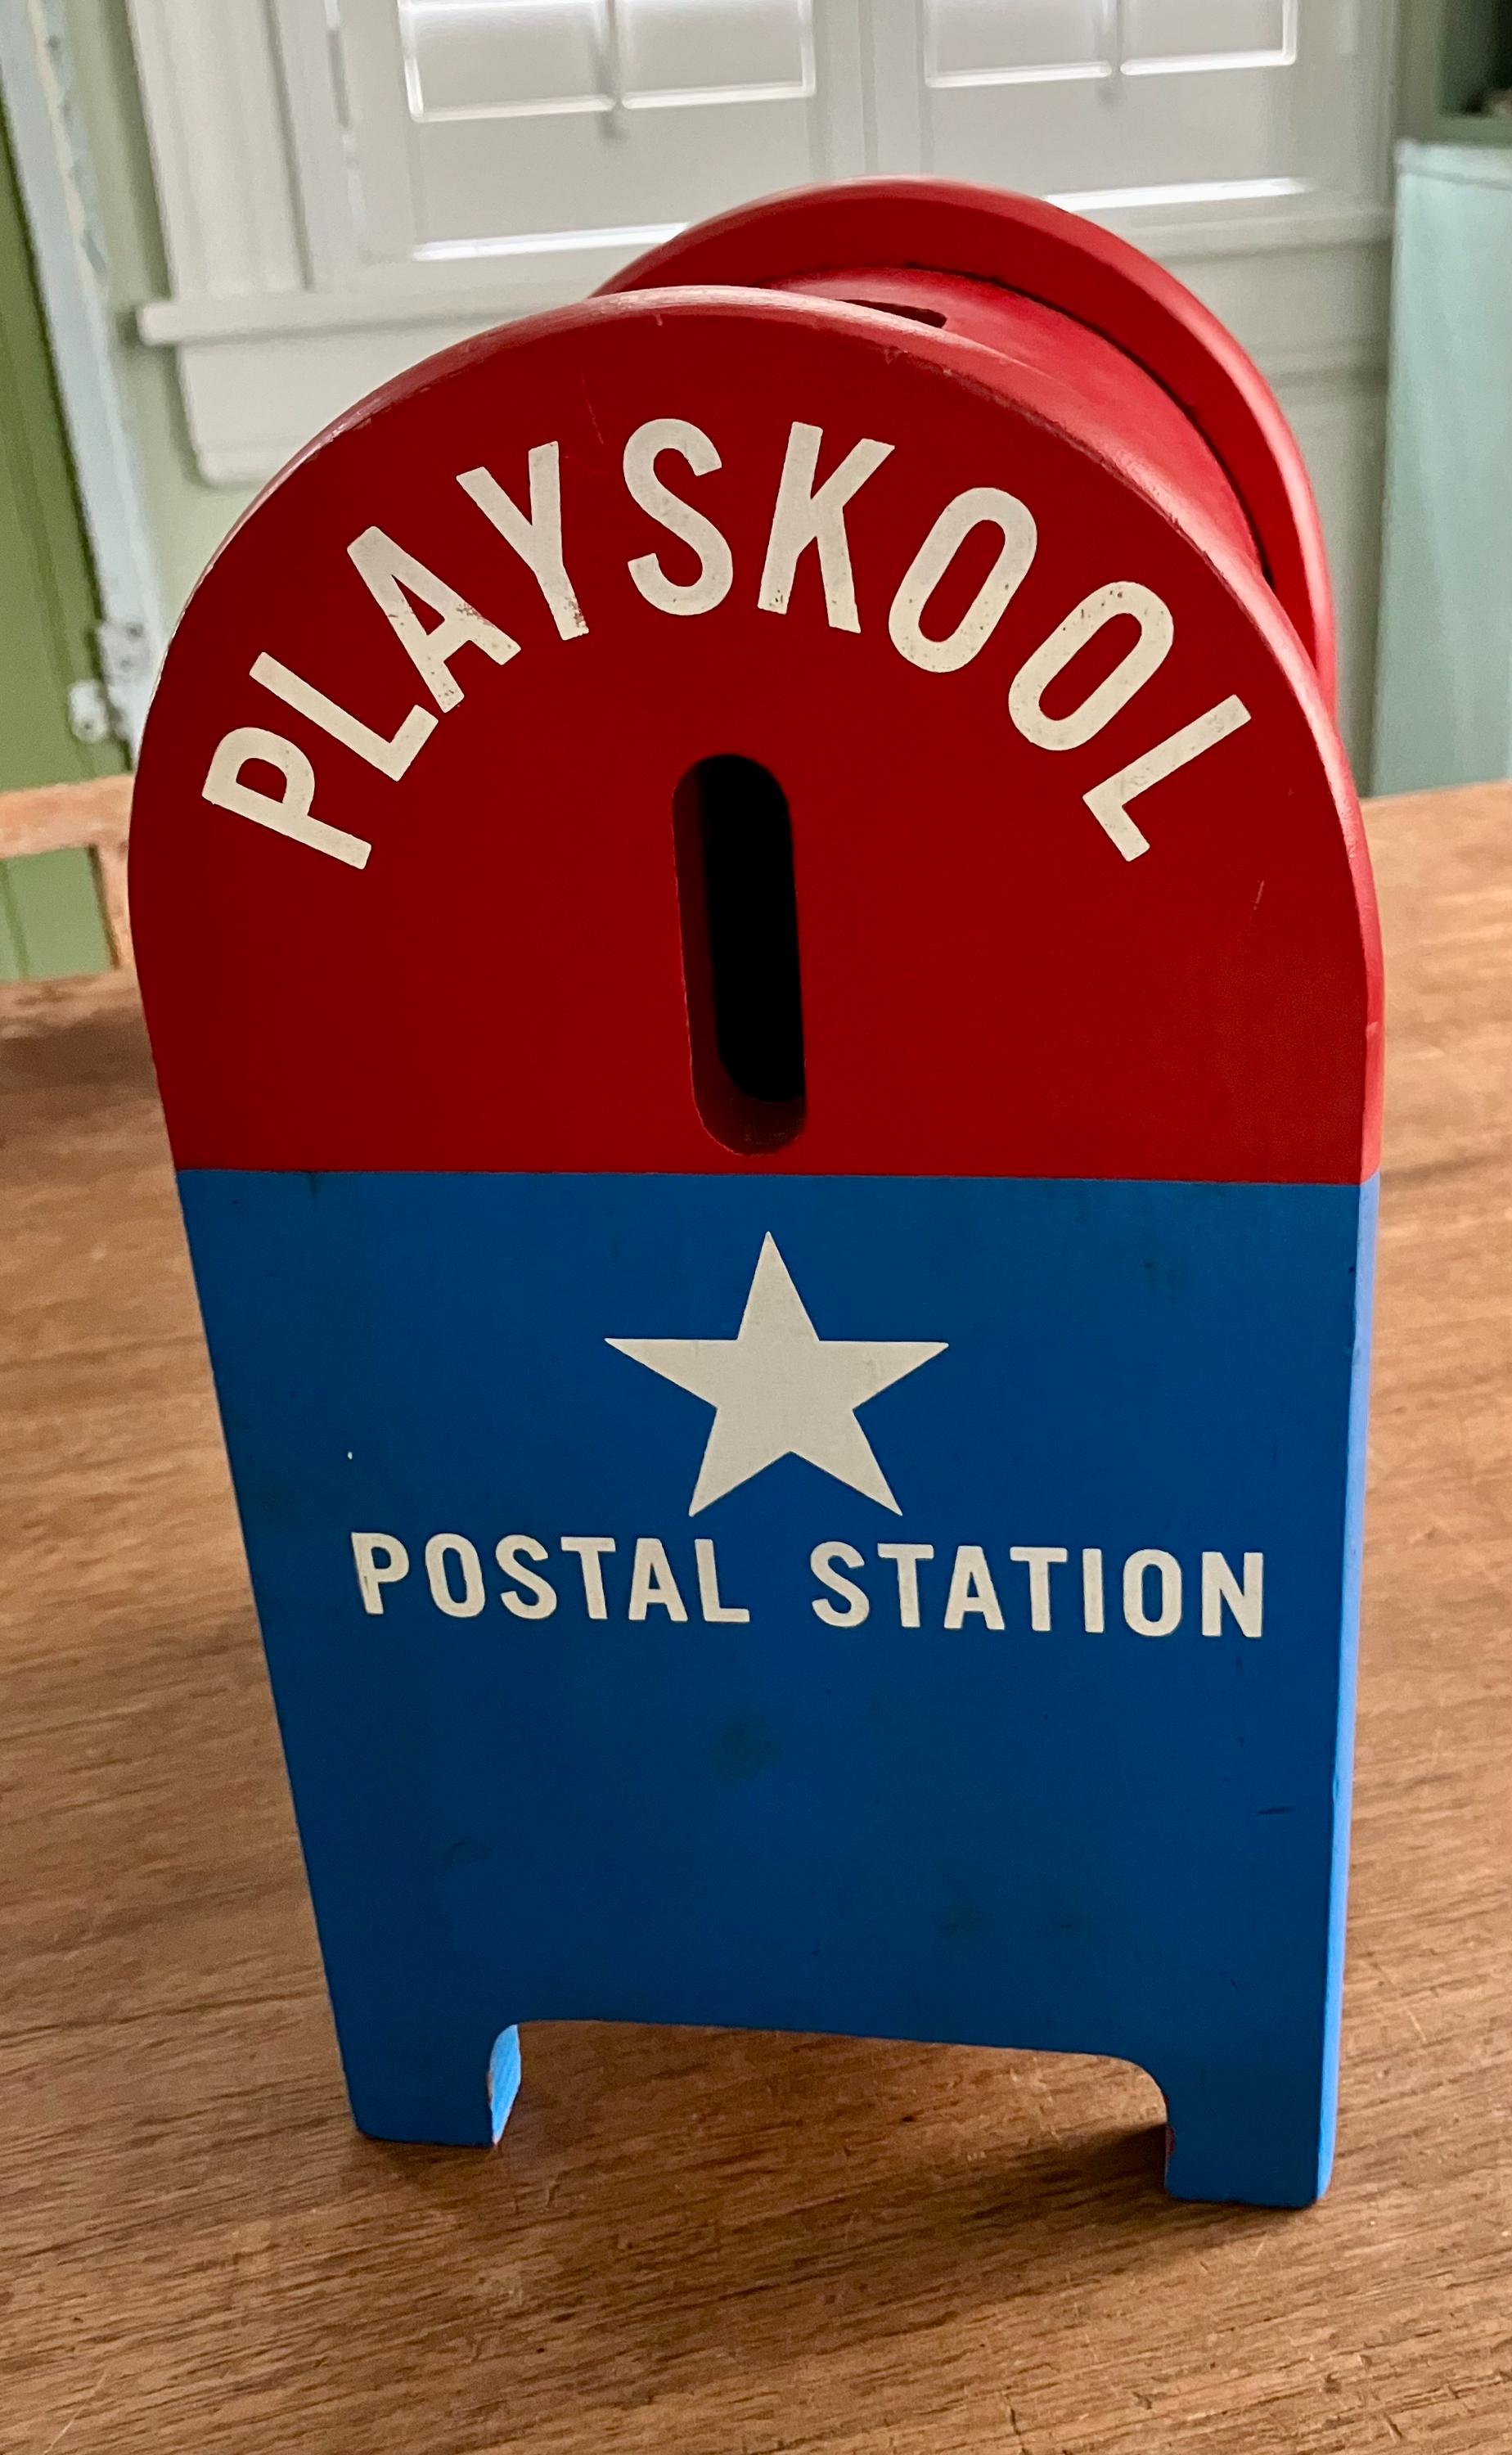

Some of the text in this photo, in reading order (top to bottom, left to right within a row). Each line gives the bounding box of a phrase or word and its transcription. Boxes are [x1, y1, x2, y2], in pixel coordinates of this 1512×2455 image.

[201, 418, 1251, 871] PLAYSKOOL
[351, 1531, 1264, 1639] POSTAL STATION
